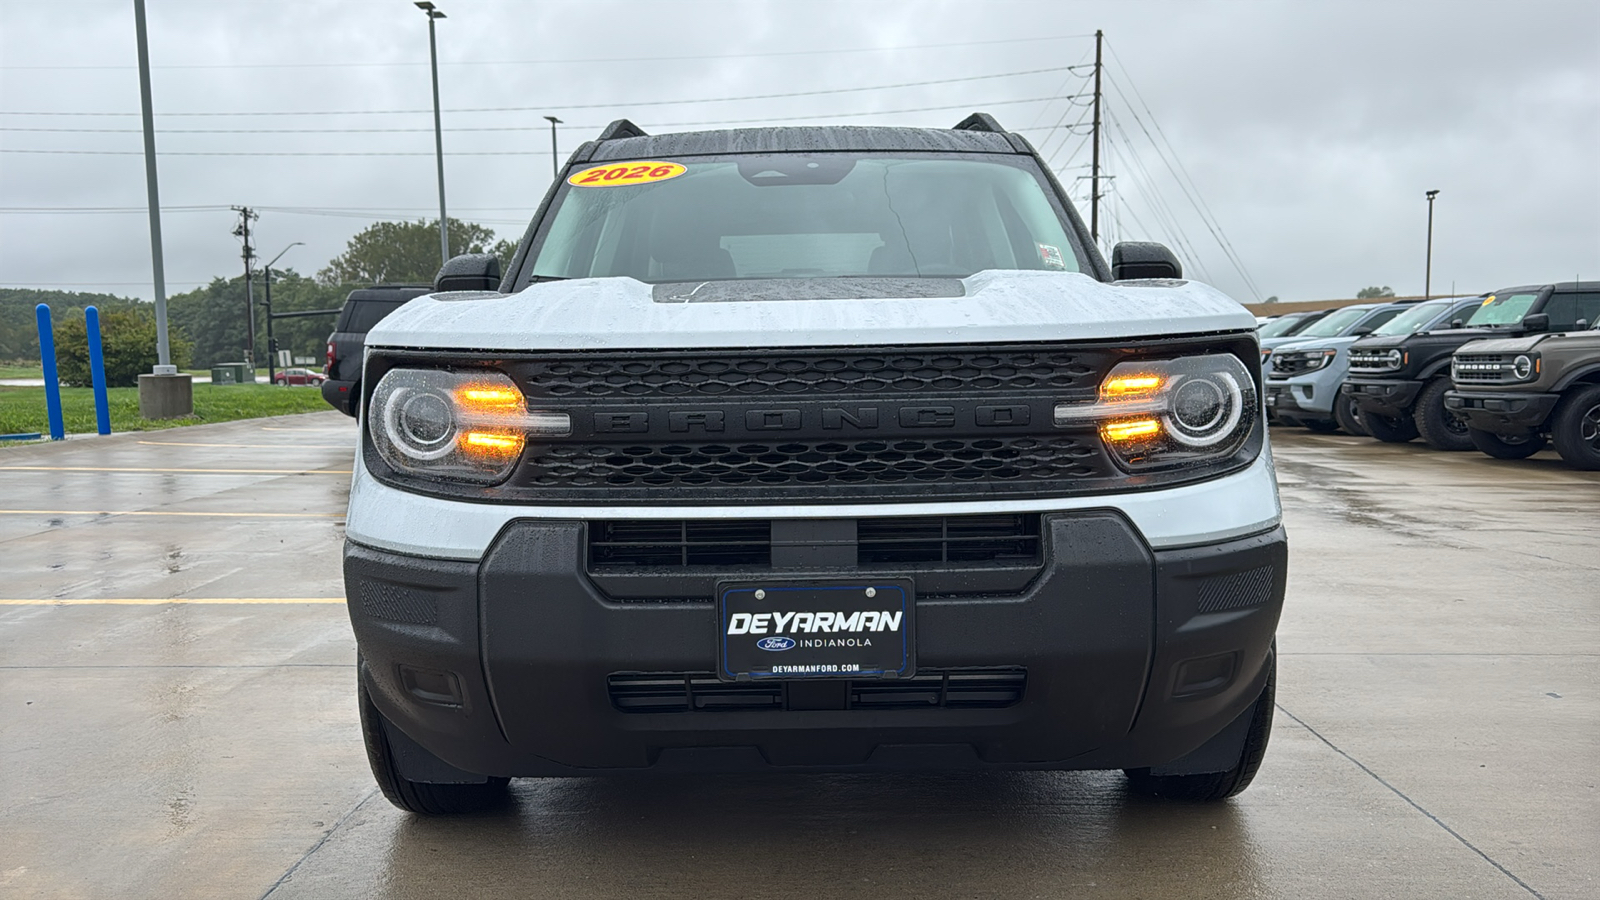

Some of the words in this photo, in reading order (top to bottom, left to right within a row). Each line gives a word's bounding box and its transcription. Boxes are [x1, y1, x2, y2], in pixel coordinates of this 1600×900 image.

[578, 165, 674, 184] 2026
[594, 405, 1030, 433] BRONCO
[727, 611, 903, 635] DEYARMAN
[800, 638, 872, 648] INDIANOLA
[772, 664, 860, 673] DEYARMANFORD.COM
